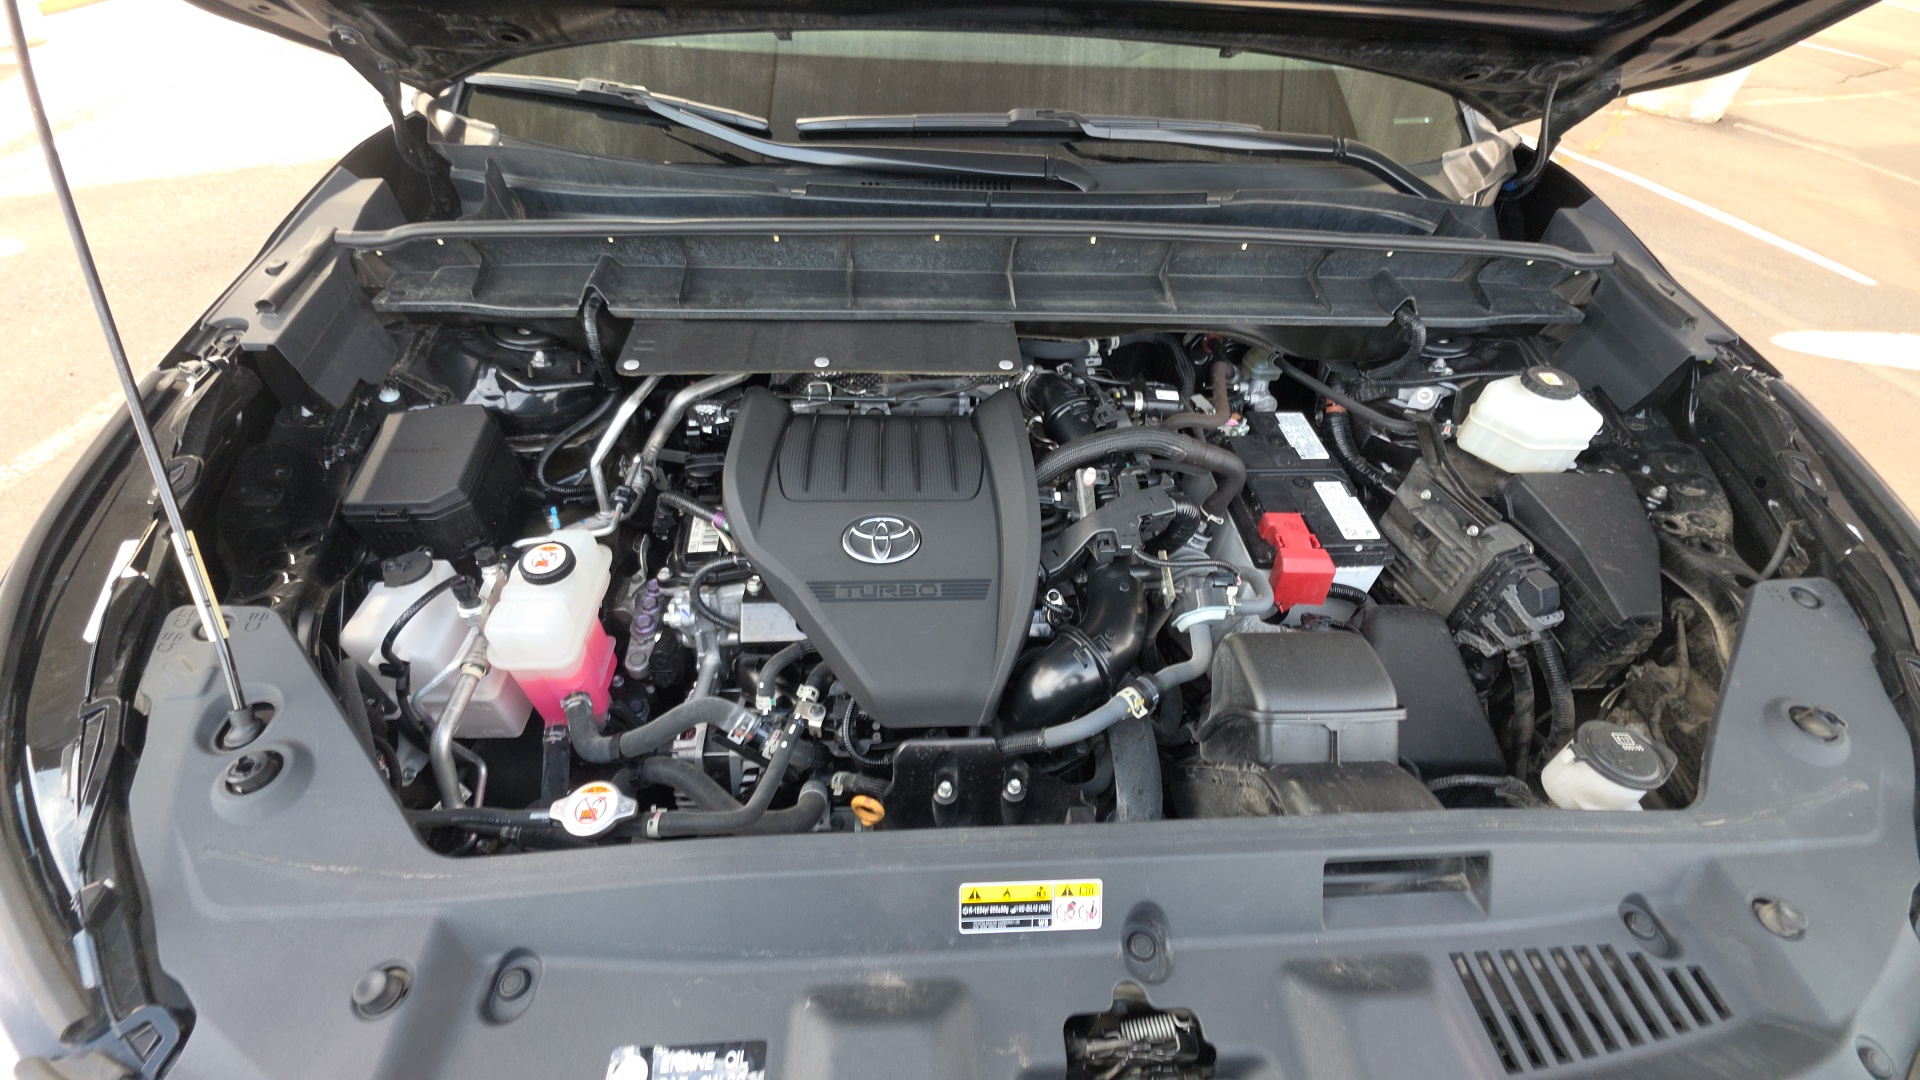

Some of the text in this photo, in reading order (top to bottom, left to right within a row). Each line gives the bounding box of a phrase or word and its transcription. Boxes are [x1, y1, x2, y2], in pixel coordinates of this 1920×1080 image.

[839, 584, 938, 598] TURBO
[661, 1050, 749, 1073] ENGINE OIL
